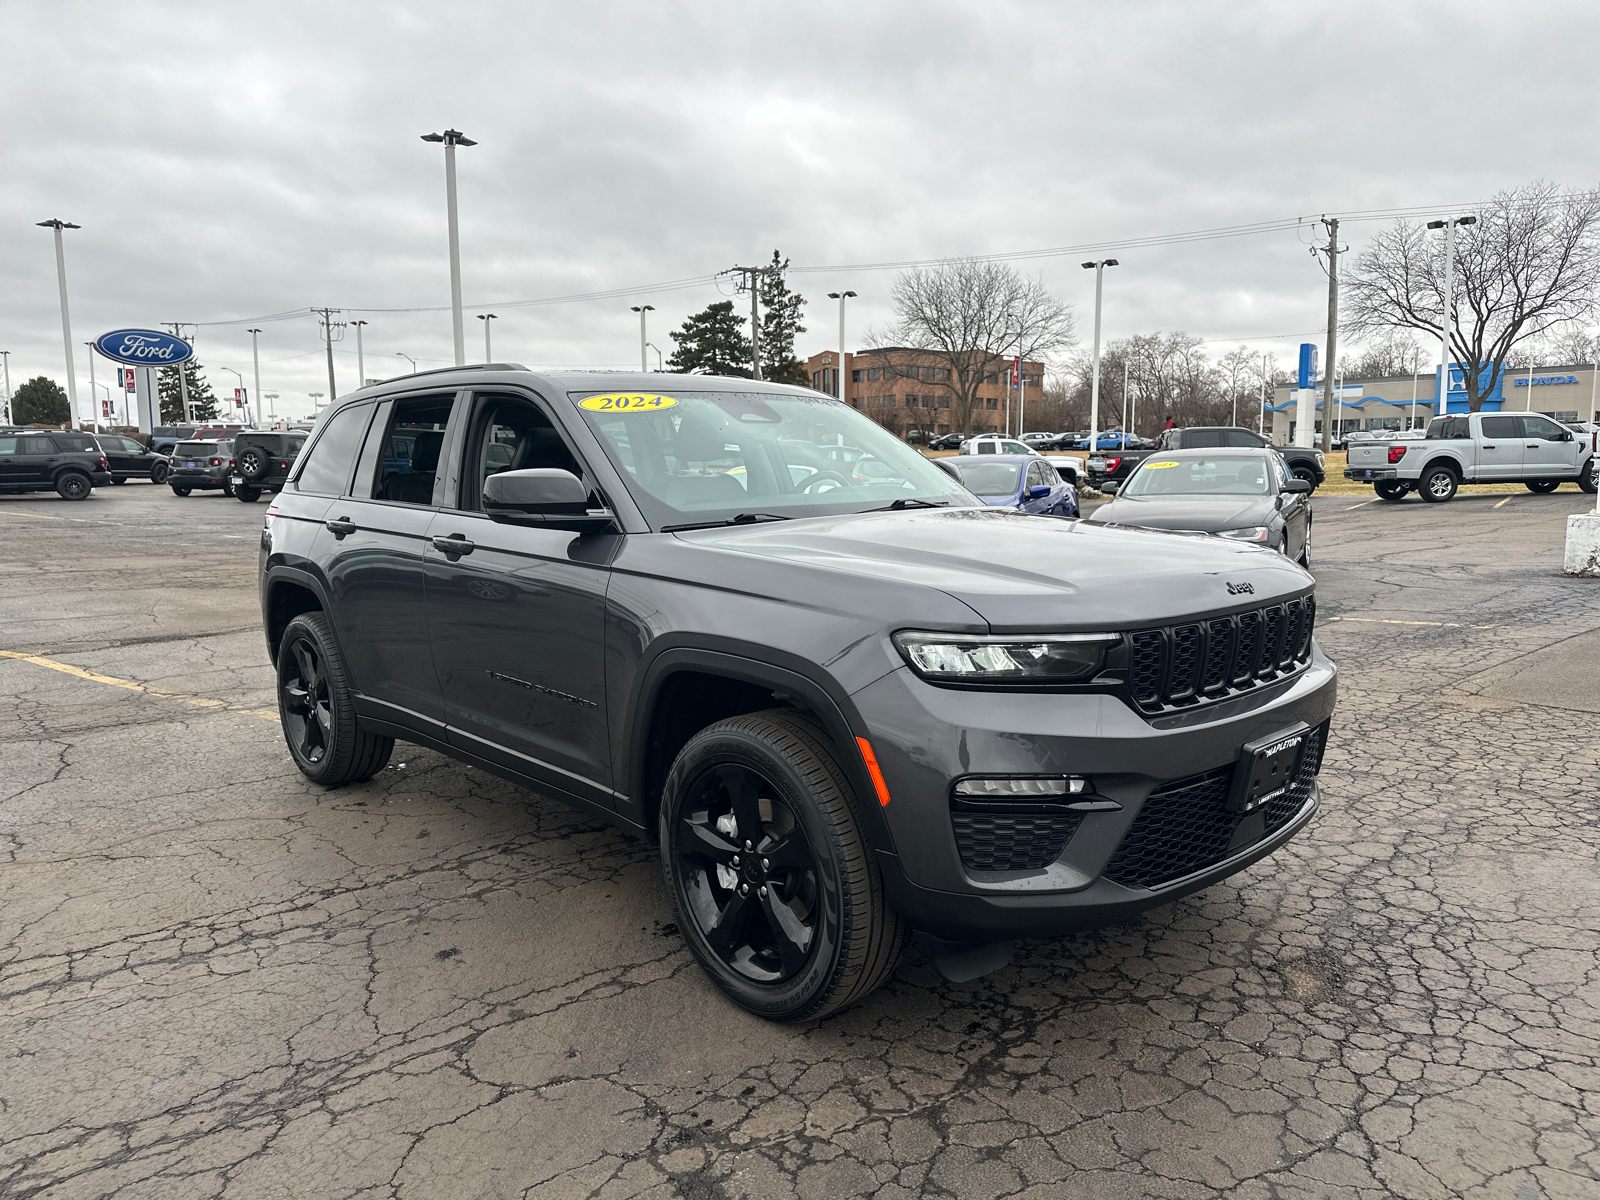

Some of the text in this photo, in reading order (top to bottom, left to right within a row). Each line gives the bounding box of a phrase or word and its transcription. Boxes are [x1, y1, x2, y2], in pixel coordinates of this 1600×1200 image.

[119, 335, 174, 359] Ford
[1514, 375, 1579, 387] HONDA
[599, 396, 662, 410] 2024
[1226, 582, 1255, 595] Jeep
[1266, 738, 1298, 757] MAPLETON
